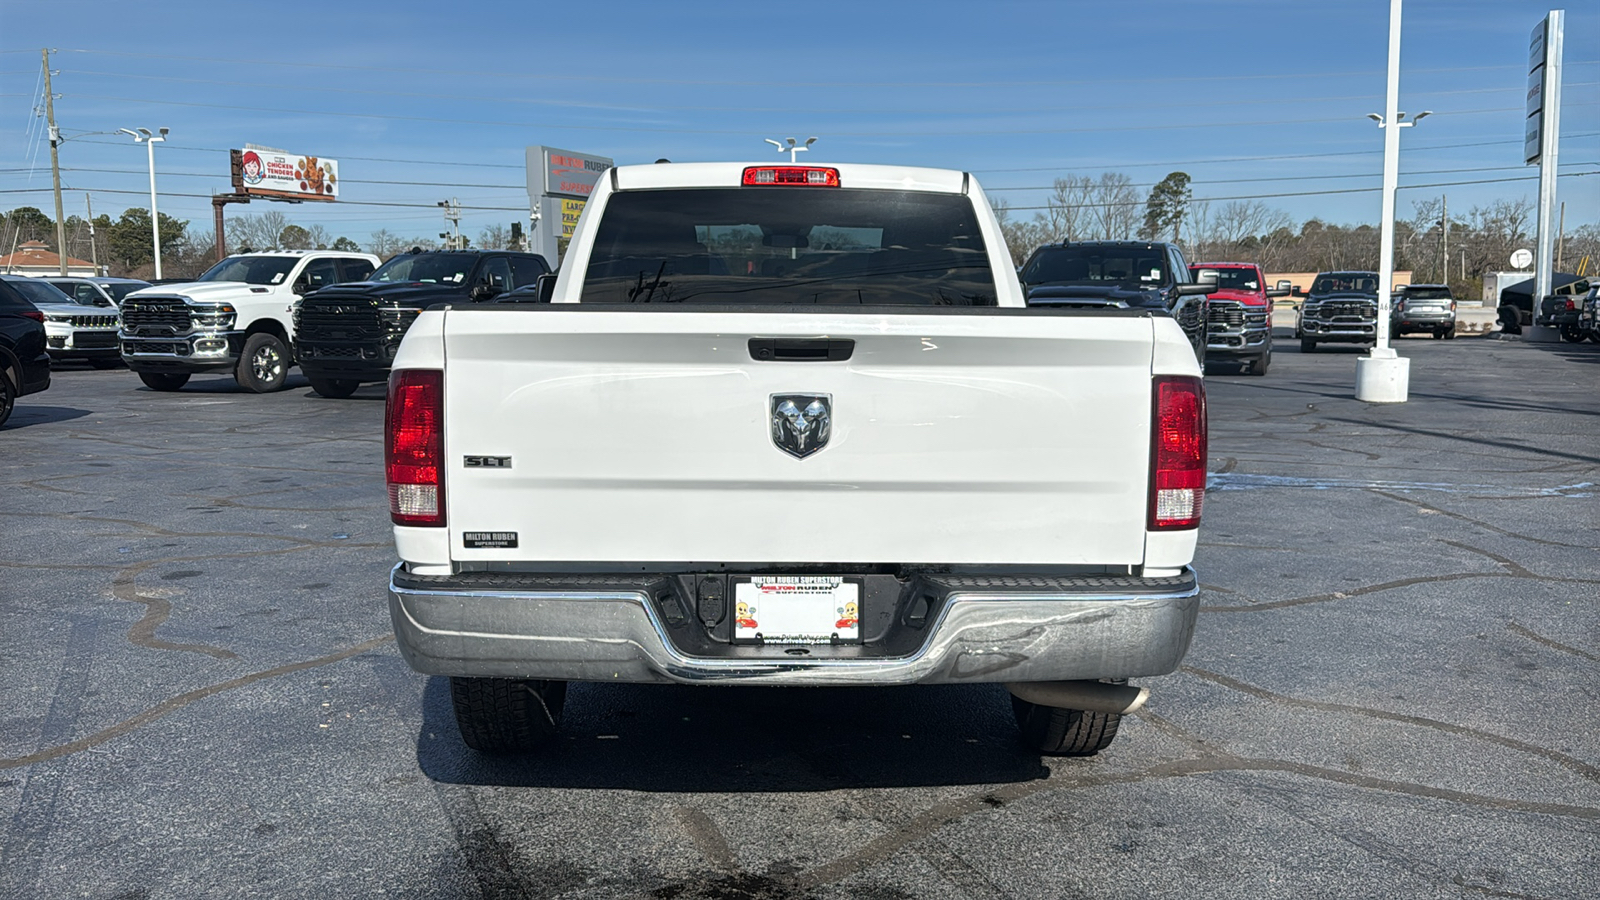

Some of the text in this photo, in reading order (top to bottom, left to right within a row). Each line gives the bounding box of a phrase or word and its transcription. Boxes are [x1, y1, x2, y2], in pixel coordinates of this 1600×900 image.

[267, 161, 294, 170] CHICKEN
[551, 154, 584, 169] MILTON
[267, 168, 294, 177] TENDERS
[560, 181, 594, 194] SUPERST
[138, 304, 170, 313] RAM
[320, 306, 357, 314] RAM
[463, 455, 512, 469] SLT
[465, 533, 516, 541] MILTON RUBEN
[751, 576, 844, 584] MILTON RUBEN SUPERSTORE
